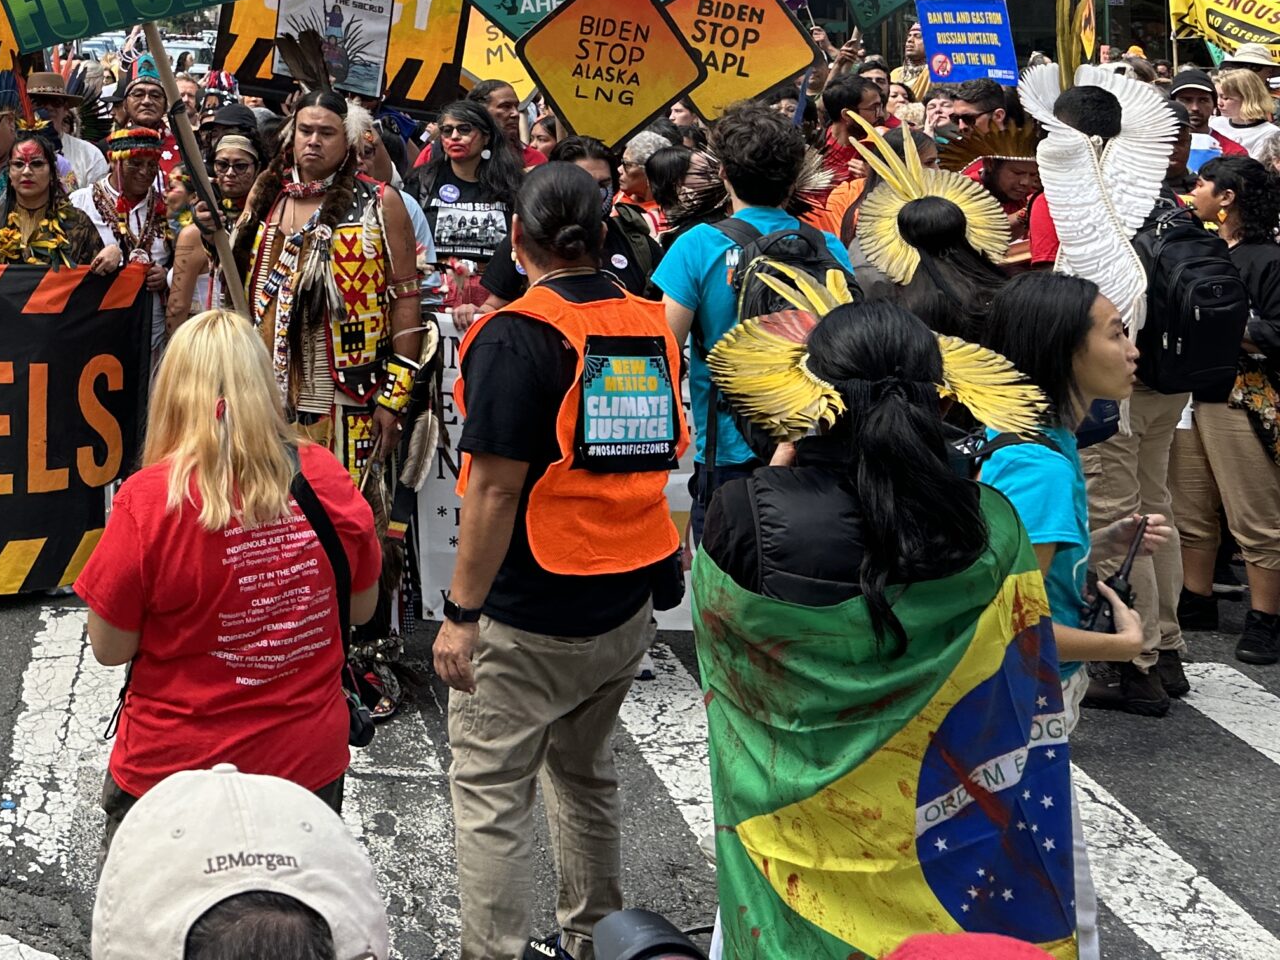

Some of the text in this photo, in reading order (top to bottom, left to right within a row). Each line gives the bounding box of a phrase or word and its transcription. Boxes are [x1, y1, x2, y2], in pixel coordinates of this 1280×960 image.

[579, 15, 651, 43] BIDEN
[927, 12, 1003, 25] BAN OIL AND GAS FROM
[1208, 13, 1222, 28] NO
[691, 20, 760, 51] STOP
[936, 32, 1002, 47] RUSSIAN DICTATOR,
[575, 39, 645, 67] STOP
[951, 52, 997, 66] END THE WAR
[571, 63, 640, 86] ALASKA
[575, 85, 635, 106] LNG
[430, 198, 473, 211] HOLAND
[612, 359, 647, 375] NEW
[604, 376, 658, 392] MEXICO
[587, 395, 668, 417] CLIMATE
[588, 417, 668, 440] JUSTICE
[588, 442, 670, 456] #NOSACRIFICEZONES
[226, 530, 318, 555] INDIGENOUS JUST TRANSITI
[239, 575, 258, 585] KEEP
[275, 568, 291, 578] THE
[290, 558, 318, 574] GROUND
[251, 595, 282, 607] CLIMATE
[281, 586, 311, 599] JUSTICE
[269, 637, 294, 647] WATER
[245, 654, 286, 662] RELATIONS
[204, 851, 299, 875] J.P.Morgan
